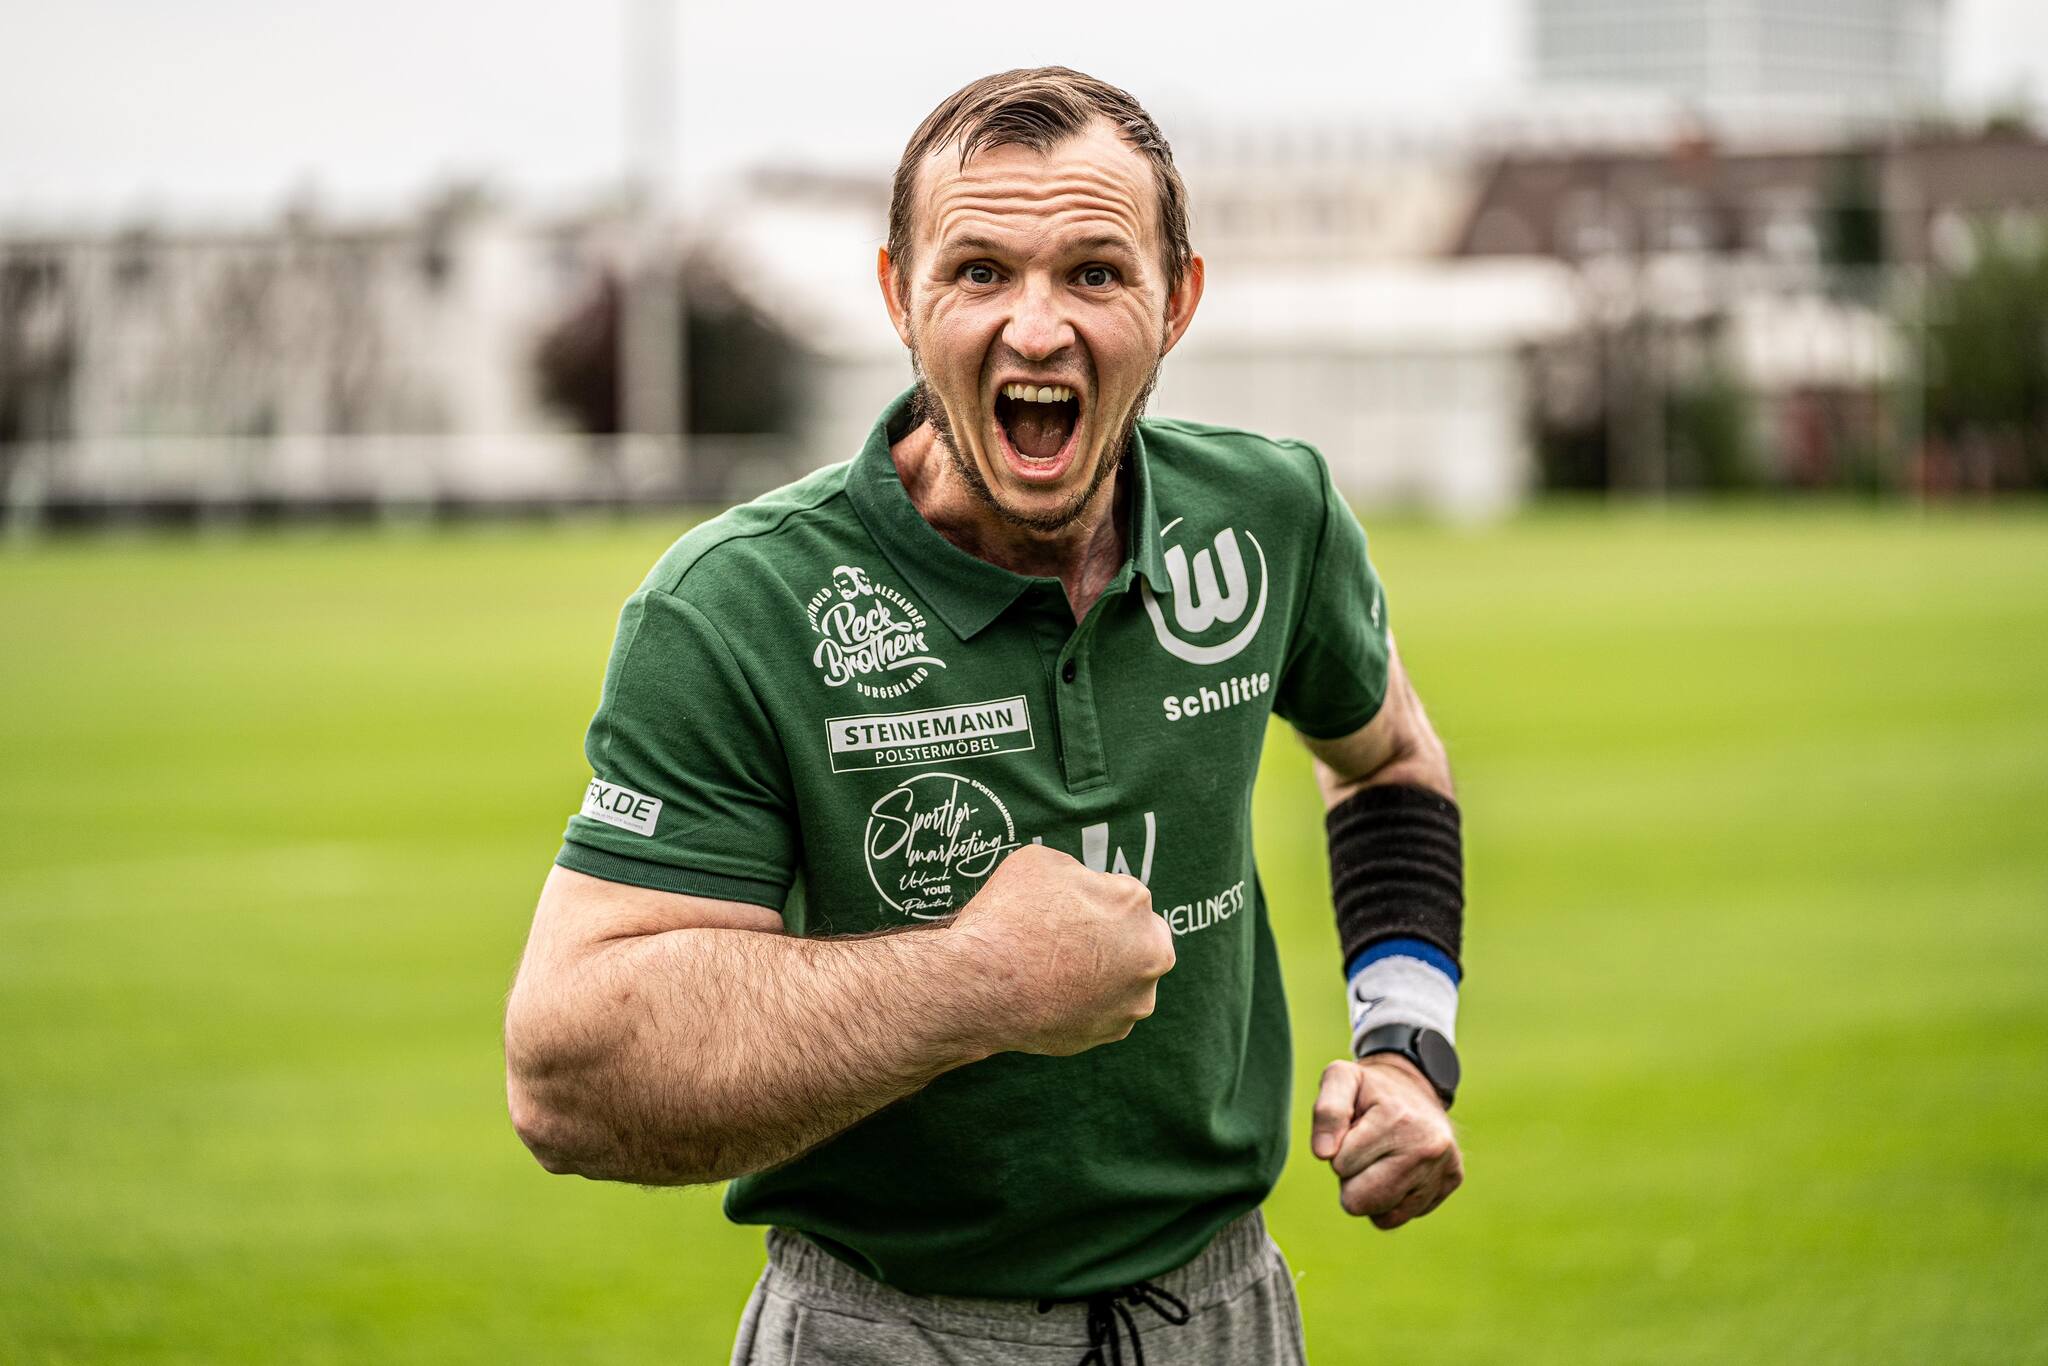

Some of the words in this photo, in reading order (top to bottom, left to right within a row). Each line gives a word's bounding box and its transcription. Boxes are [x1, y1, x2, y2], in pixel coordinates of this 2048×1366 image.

[821, 598, 913, 653] Peck
[874, 583, 927, 630] ALEXANDER
[812, 631, 931, 687] Brothers
[857, 667, 928, 699] BURGENLAND
[1163, 672, 1270, 721] Schlitte
[845, 708, 1013, 746] STEINEMANN
[875, 737, 999, 764] POLSTERMÖBEL
[907, 829, 1021, 878] marketing
[922, 884, 951, 896] YOUR
